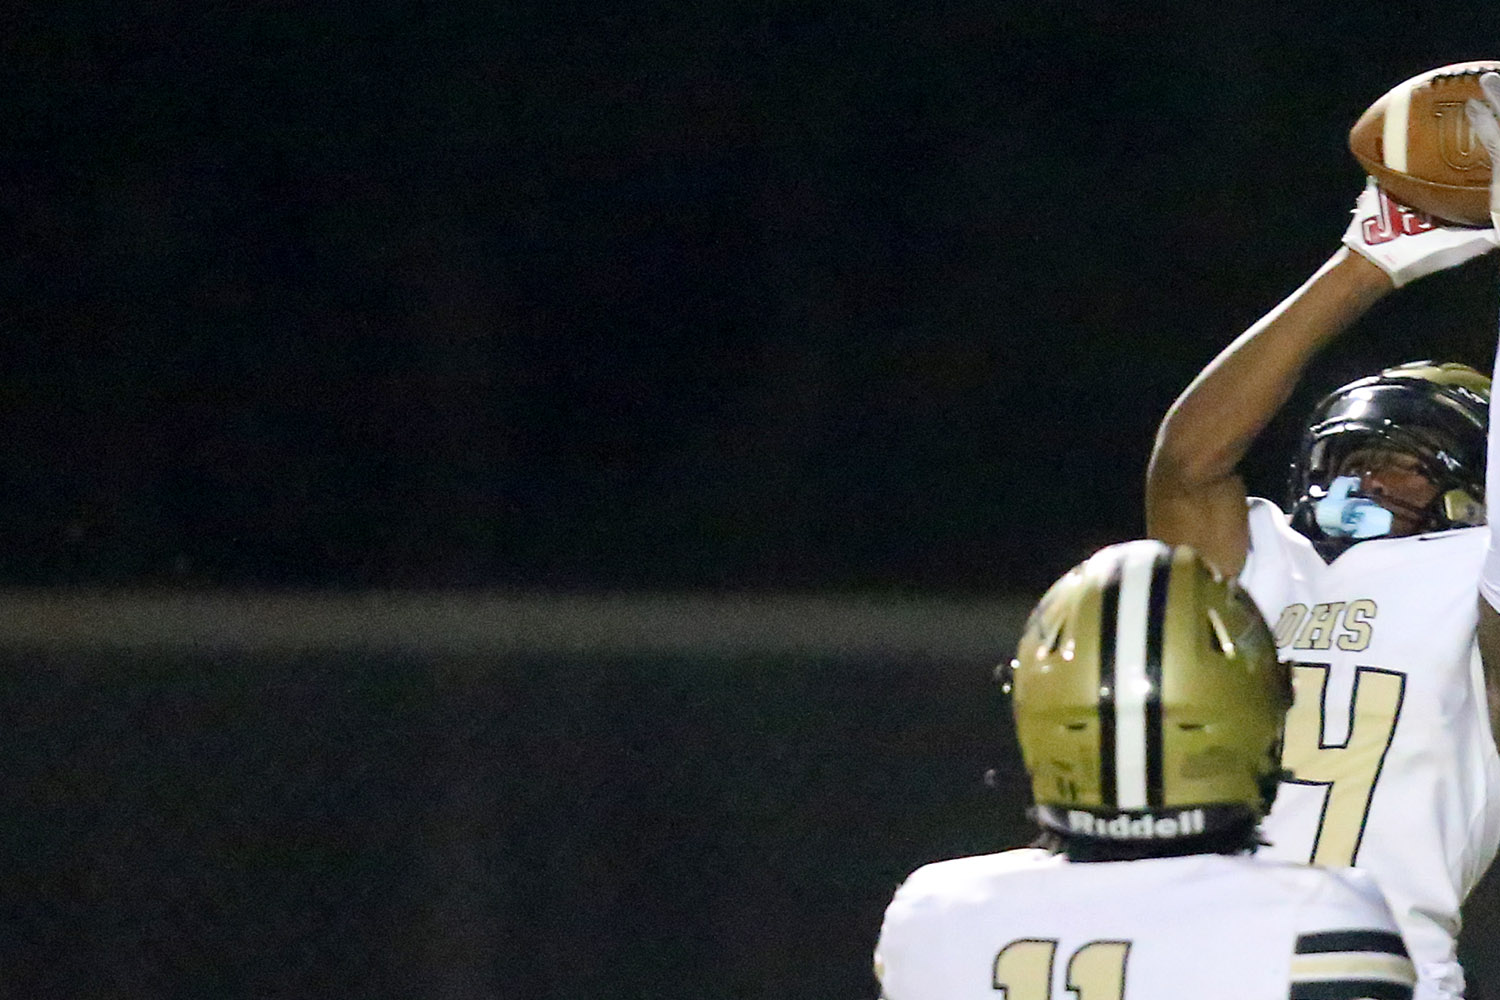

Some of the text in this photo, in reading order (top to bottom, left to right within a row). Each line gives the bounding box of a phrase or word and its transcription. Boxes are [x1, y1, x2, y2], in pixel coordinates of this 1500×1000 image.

[1276, 599, 1377, 652] OHS
[1280, 661, 1406, 867] 4
[1067, 808, 1206, 838] Riddell
